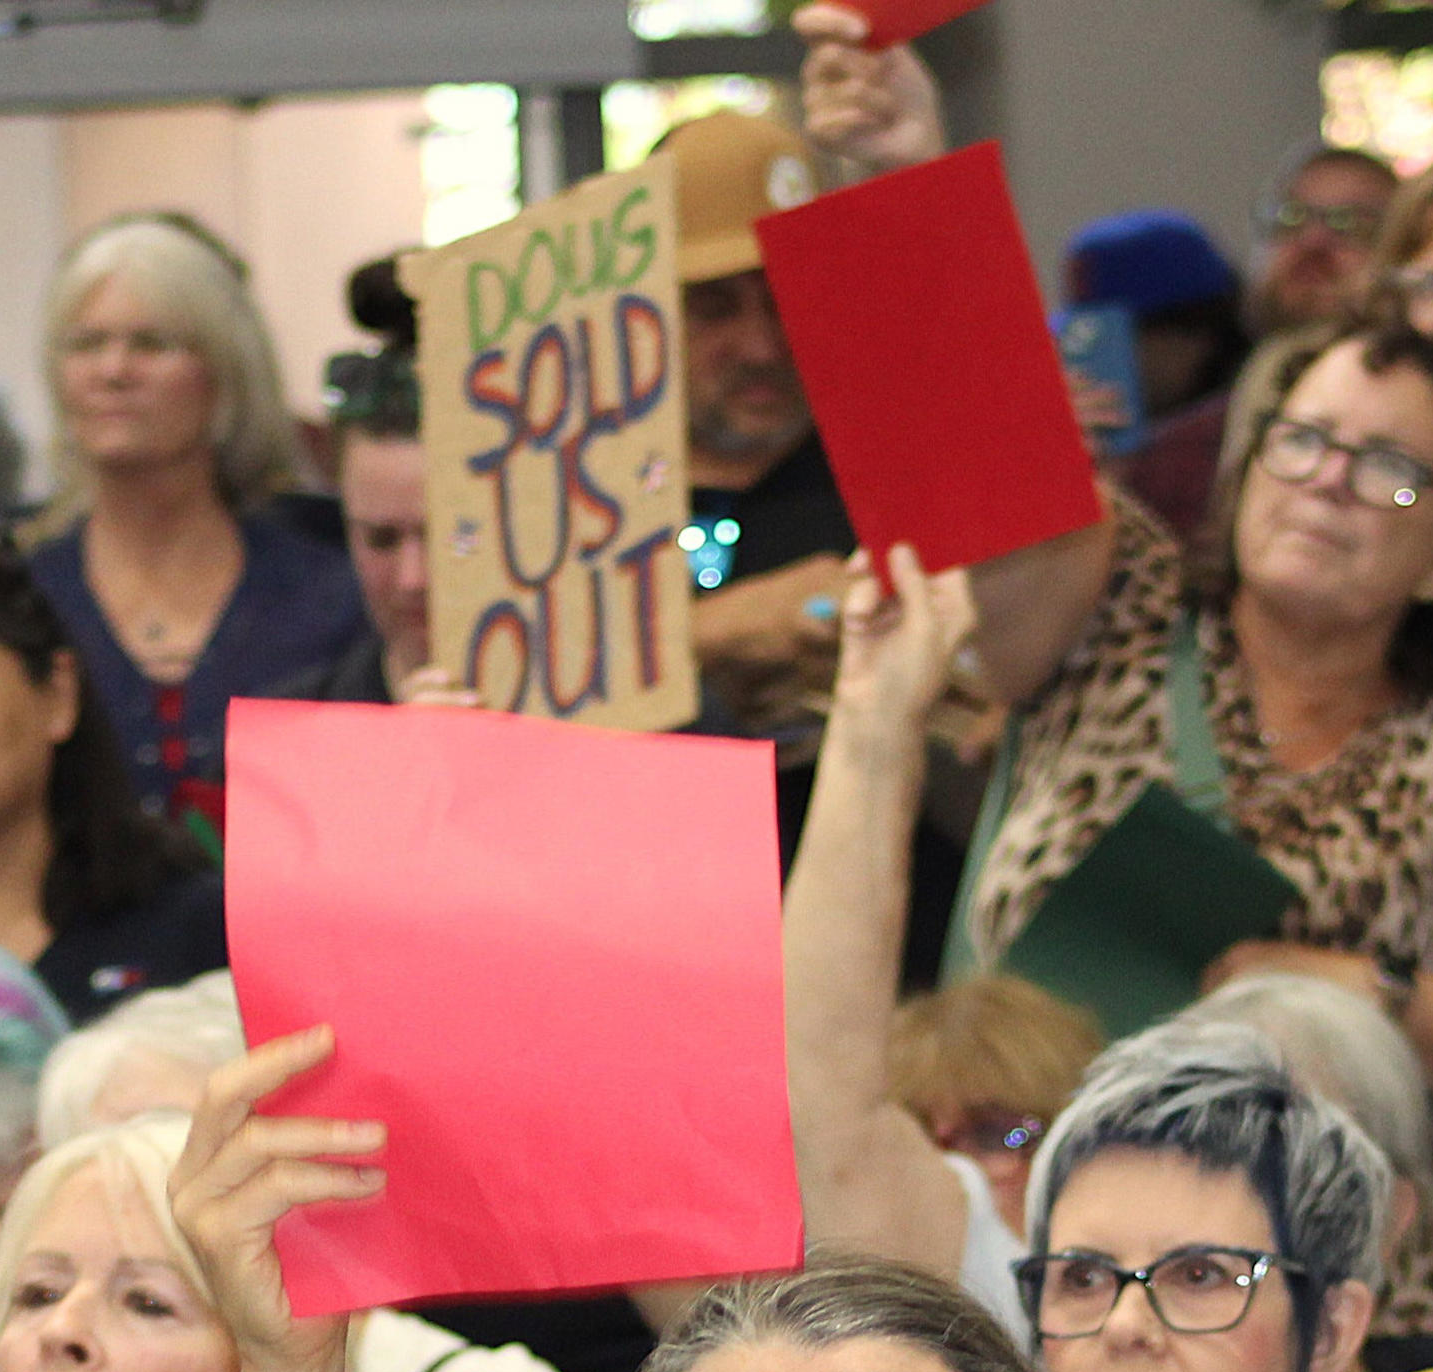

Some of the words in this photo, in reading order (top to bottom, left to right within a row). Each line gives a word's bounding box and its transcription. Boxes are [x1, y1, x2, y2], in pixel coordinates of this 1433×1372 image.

[464, 293, 668, 473] SOLD
[495, 409, 624, 592] US
[466, 524, 675, 714] OUT
